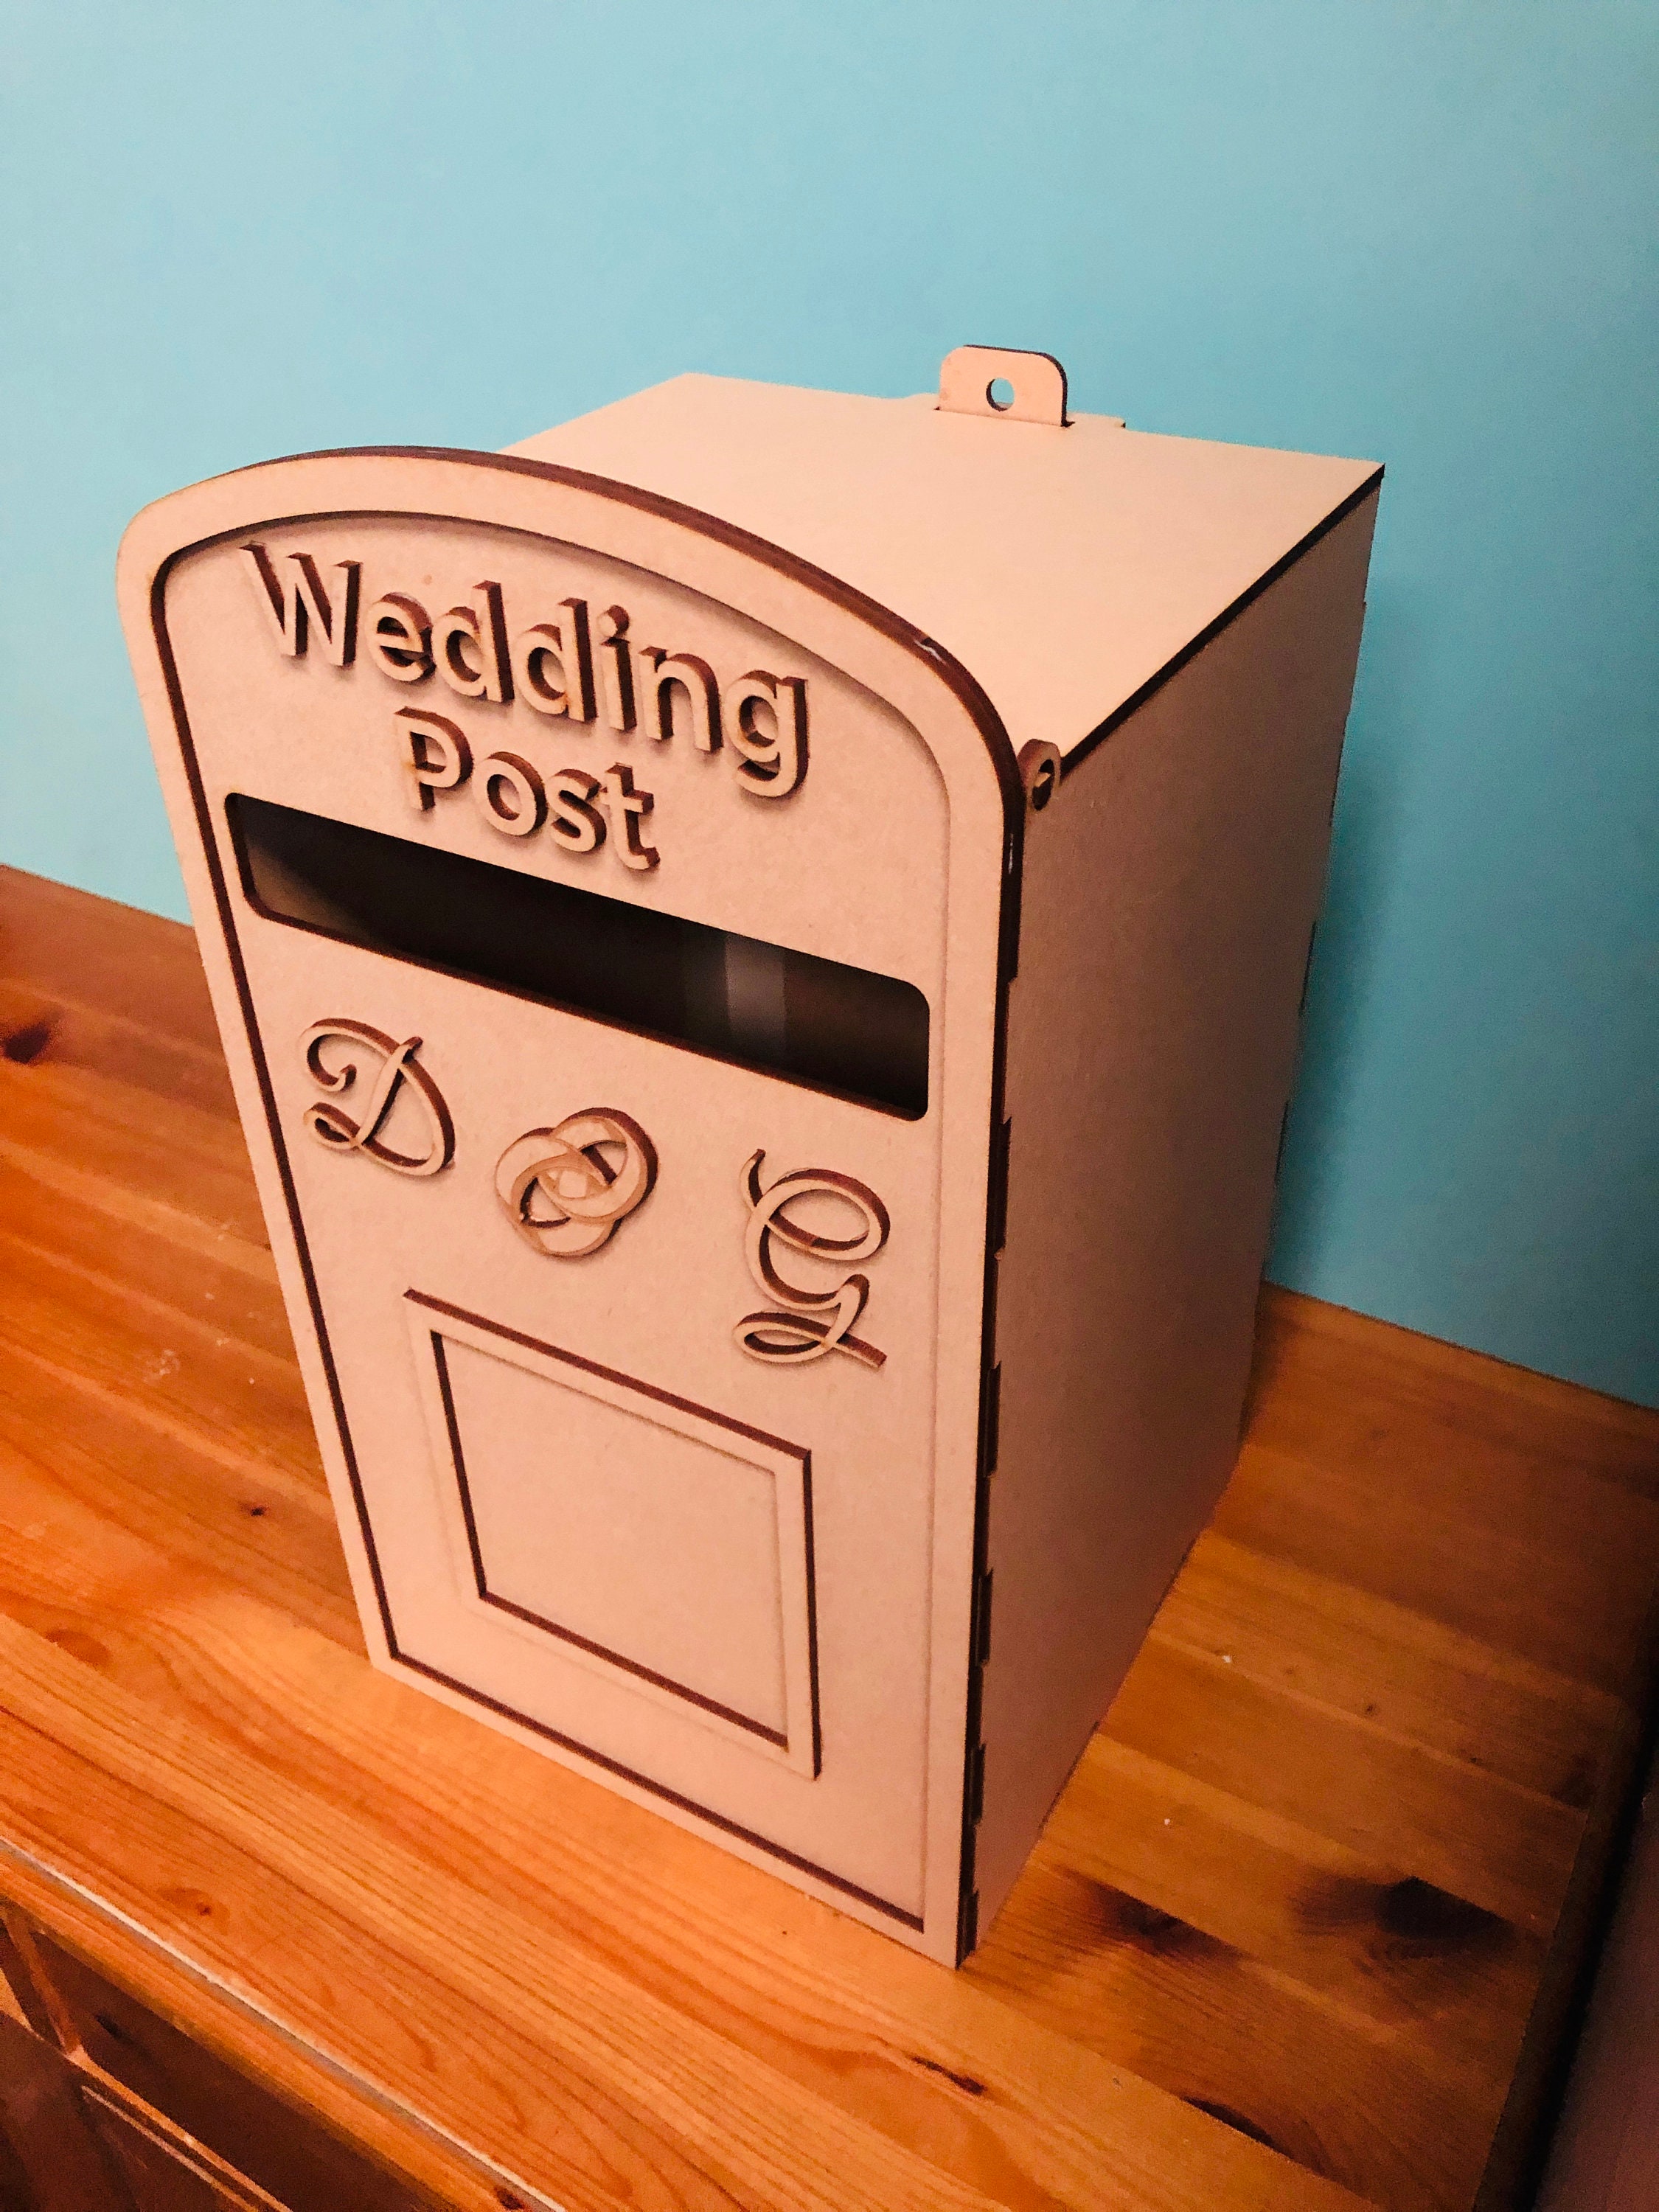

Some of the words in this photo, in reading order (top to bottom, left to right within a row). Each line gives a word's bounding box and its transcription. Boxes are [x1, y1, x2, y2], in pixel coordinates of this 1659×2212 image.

[240, 541, 810, 799] Wedding
[394, 706, 661, 871] Post
[299, 1018, 455, 1177] D
